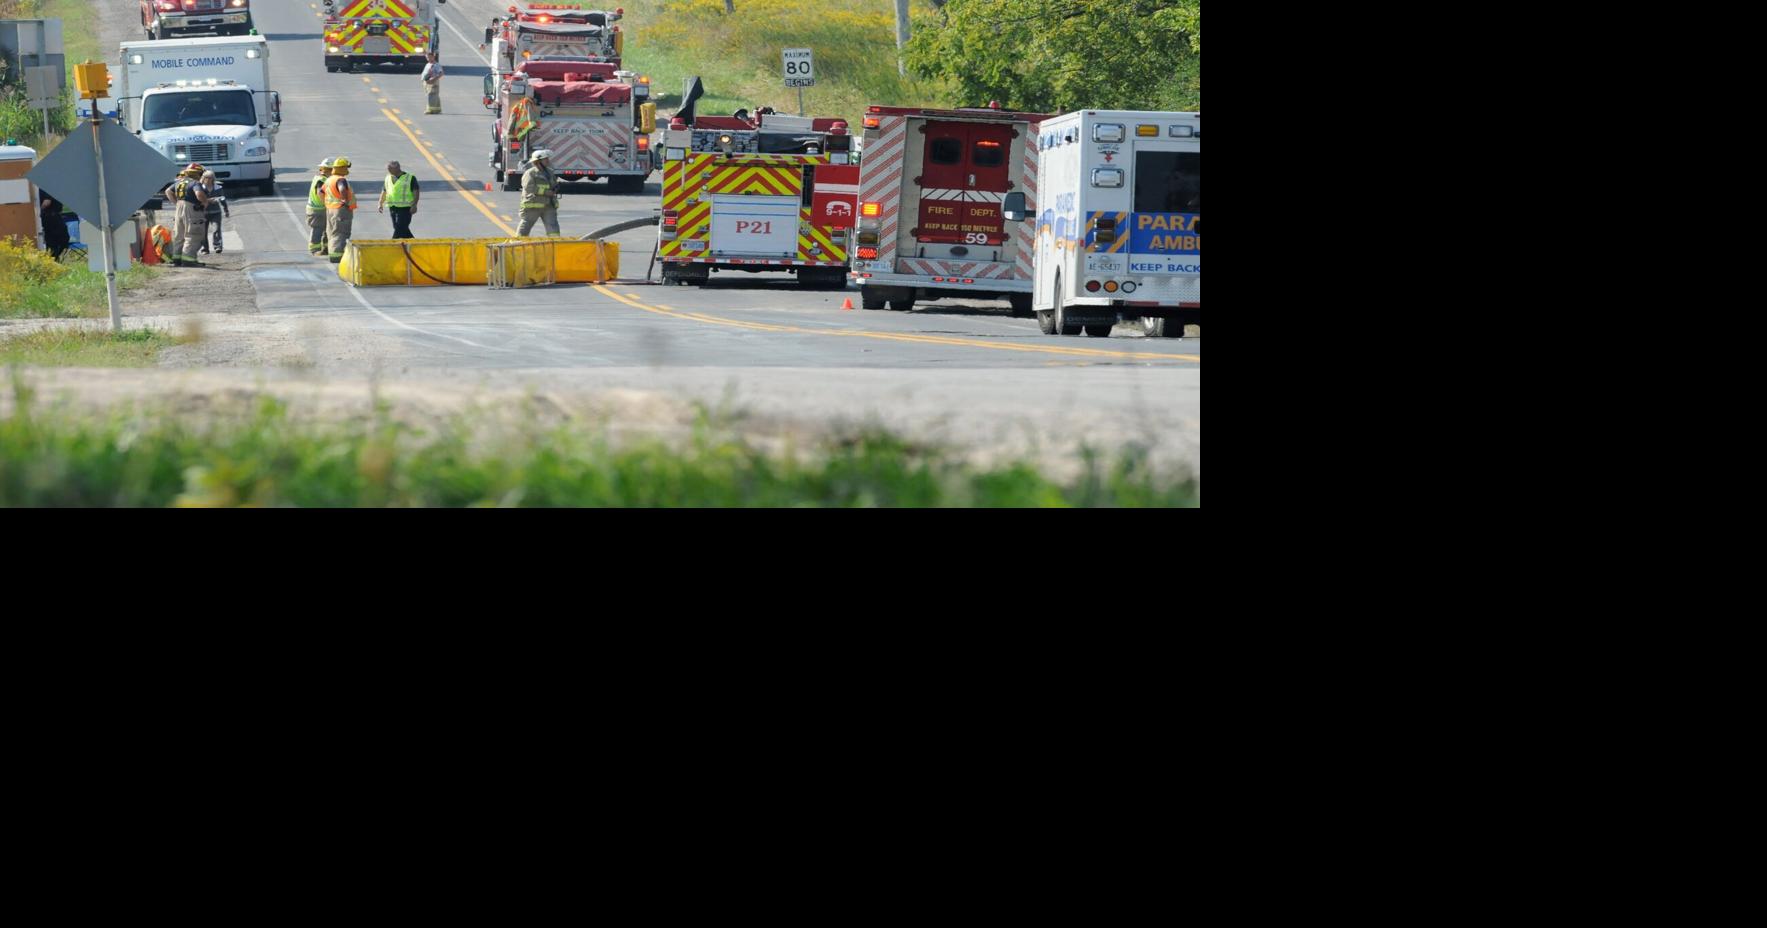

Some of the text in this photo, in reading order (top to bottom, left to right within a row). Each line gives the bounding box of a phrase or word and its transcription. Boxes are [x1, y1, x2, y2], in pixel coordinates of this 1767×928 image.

[151, 56, 235, 69] MOBILE COMMAND
[786, 61, 810, 75] 80
[826, 208, 851, 217] 9-1-1
[928, 206, 997, 217] FIRE DEPT.
[735, 220, 772, 234] P21
[965, 232, 988, 245] 59
[1131, 263, 1200, 273] KEEP BACK
